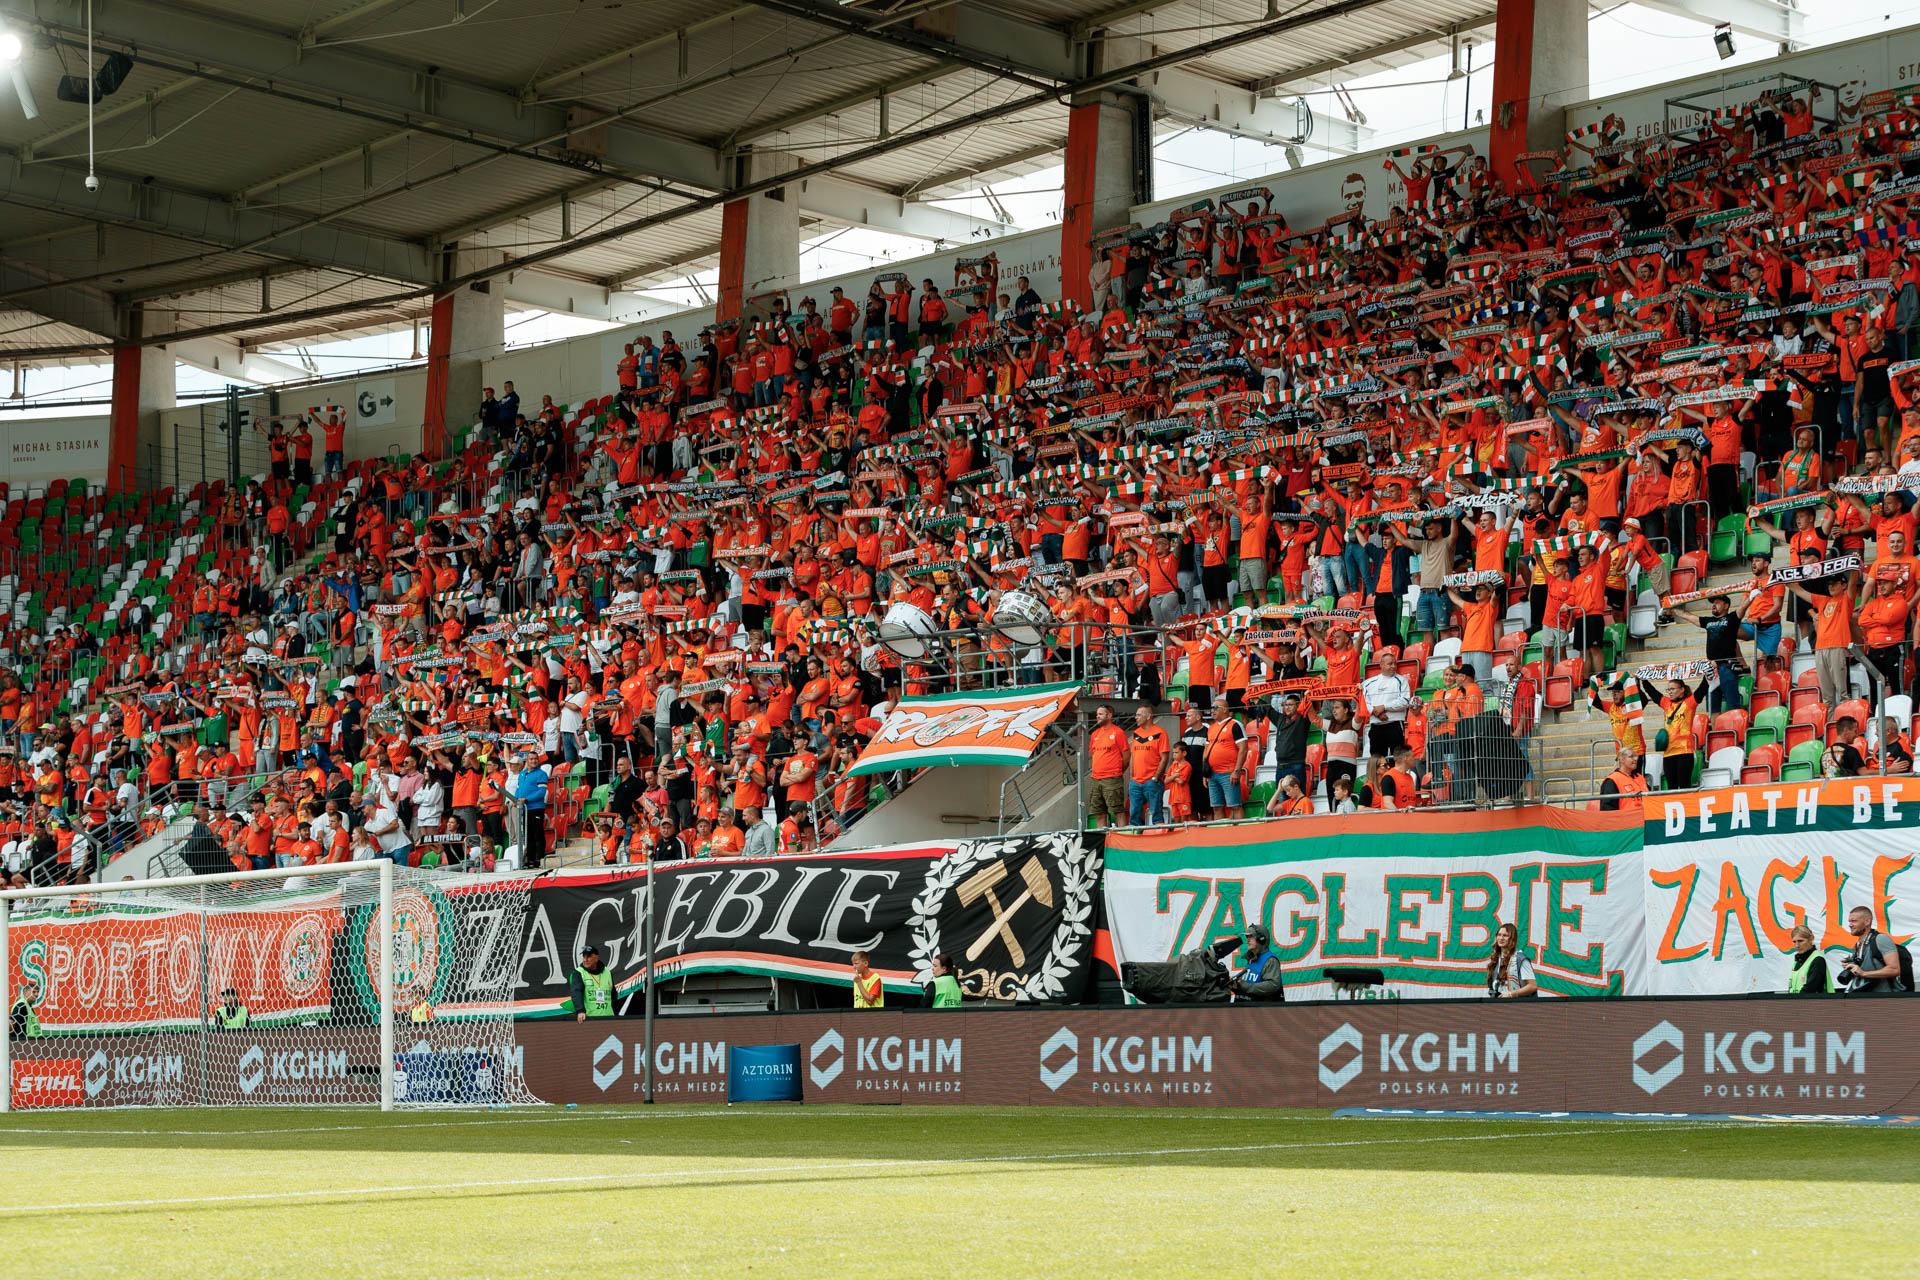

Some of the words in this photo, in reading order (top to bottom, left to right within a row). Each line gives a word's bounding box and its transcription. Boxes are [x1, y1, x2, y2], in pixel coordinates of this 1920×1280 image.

[358, 390, 377, 418] G
[239, 409, 250, 437] F
[12, 442, 51, 453] MICHAŁ
[56, 440, 99, 451] STASIAK
[1664, 786, 1819, 837] DEATH
[19, 923, 283, 1010] SPORTOWY
[596, 1002, 609, 1010] 247
[272, 1050, 346, 1080] KGHM
[634, 1042, 726, 1075] KGHM
[857, 1037, 962, 1073] KGHM
[1093, 1036, 1213, 1073] KGHM
[1381, 1032, 1519, 1073] KGHM
[1704, 1031, 1865, 1074] KGHM
[18, 1074, 82, 1093] STIHL
[115, 1055, 183, 1084] KGHM
[742, 1064, 793, 1076] AZTORIN
[634, 1082, 680, 1092] POSKA
[688, 1080, 726, 1092] MIEDŹ
[856, 1081, 910, 1092] POLSKA
[918, 1078, 962, 1092] MIEDŹ
[1093, 1082, 1153, 1094] POLSKA
[1163, 1079, 1213, 1094] MIEDŹ
[1381, 1082, 1449, 1095] POLSKA
[1462, 1079, 1518, 1095] MIEDŹ
[1704, 1084, 1785, 1098] POLSKA
[1800, 1081, 1865, 1098] MIEDŹ
